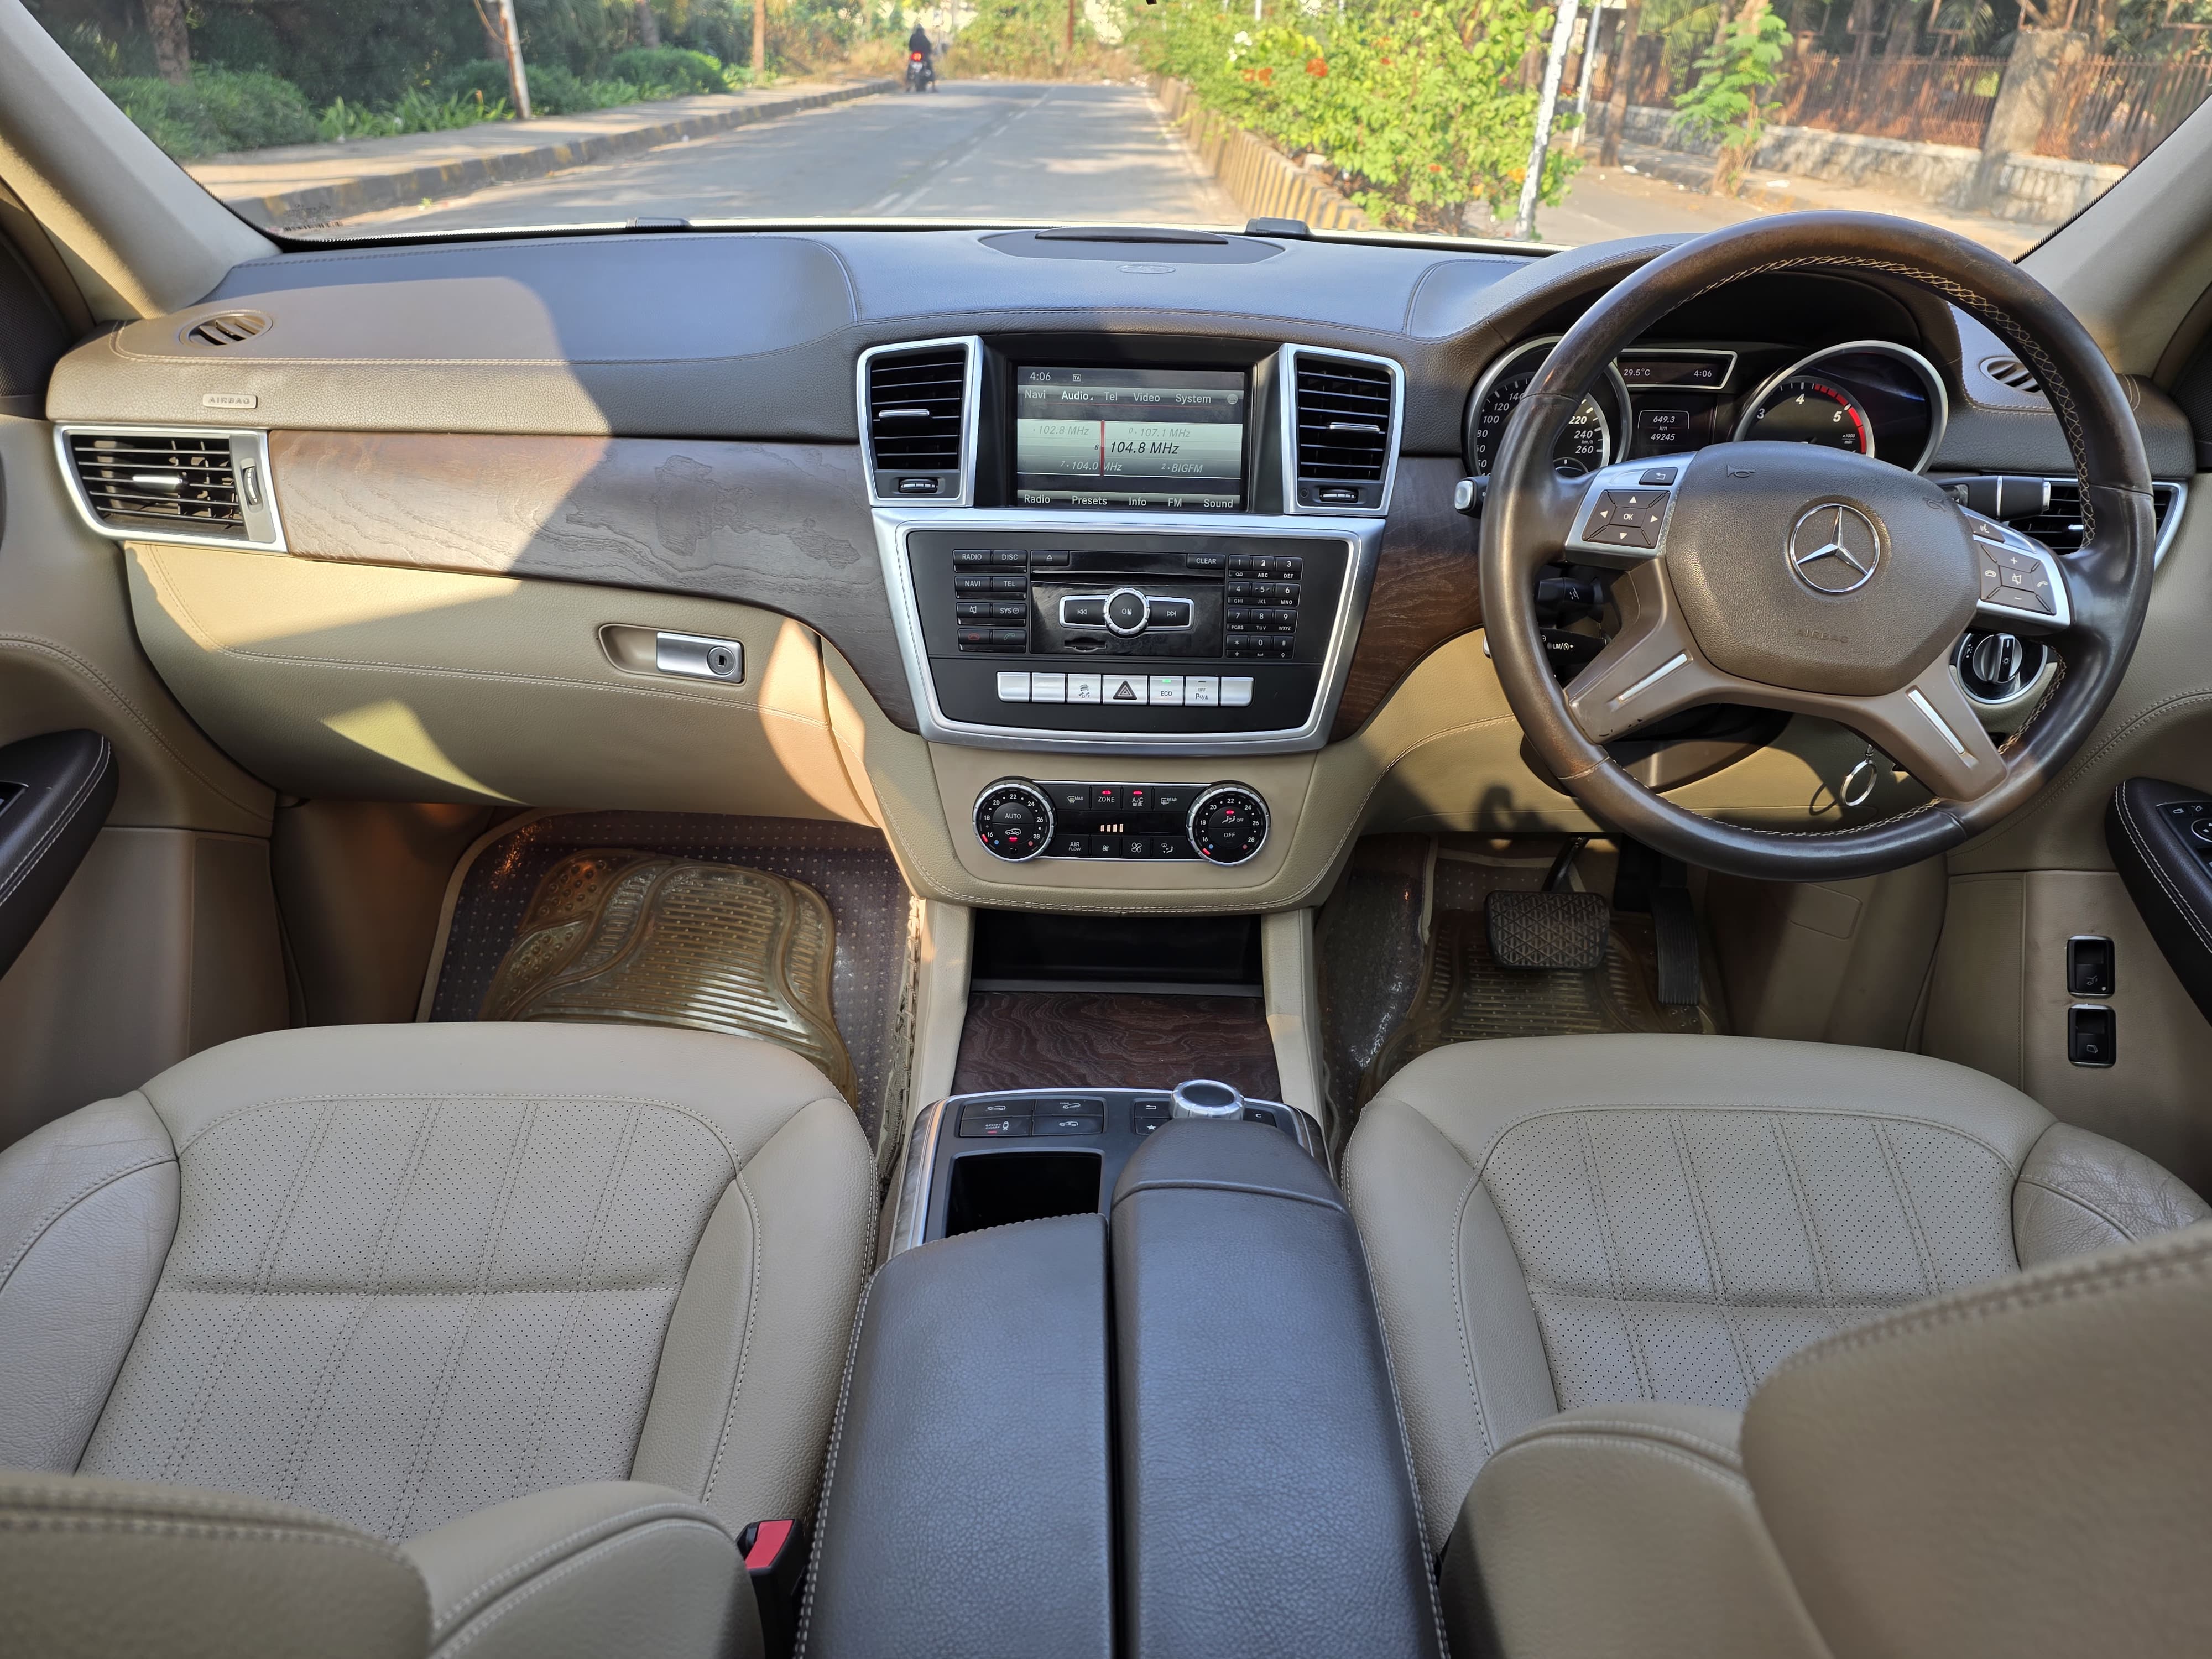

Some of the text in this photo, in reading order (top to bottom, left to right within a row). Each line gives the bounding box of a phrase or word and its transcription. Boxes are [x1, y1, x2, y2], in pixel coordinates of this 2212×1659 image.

[1030, 372, 1051, 381] 4:06
[1025, 389, 1046, 399] Navi
[1062, 390, 1089, 400] Audio
[1104, 392, 1118, 401] Tel
[1133, 393, 1160, 403] Video
[1175, 393, 1211, 405] System
[1796, 393, 1804, 405] 4
[1494, 403, 1510, 411] 120
[1757, 408, 1765, 419] 3
[1833, 411, 1842, 422] 5
[1483, 415, 1499, 424] 100
[1568, 416, 1587, 424] 220
[1039, 426, 1089, 435] 102.8 MHz
[1141, 429, 1166, 437] 107.1
[1169, 429, 1191, 437] MHz
[1574, 430, 1593, 439] 240
[1111, 441, 1146, 453] 104.8
[1150, 442, 1180, 454] MHz
[1575, 445, 1594, 453] 260
[1072, 461, 1099, 470] 104.0
[1104, 462, 1123, 471] MHz
[1171, 463, 1203, 473] BIGFM
[1024, 494, 1051, 504] Radio
[1072, 495, 1107, 506] Presets
[1129, 497, 1147, 507] Info
[1168, 498, 1182, 508] FM
[1203, 499, 1233, 509] Sound
